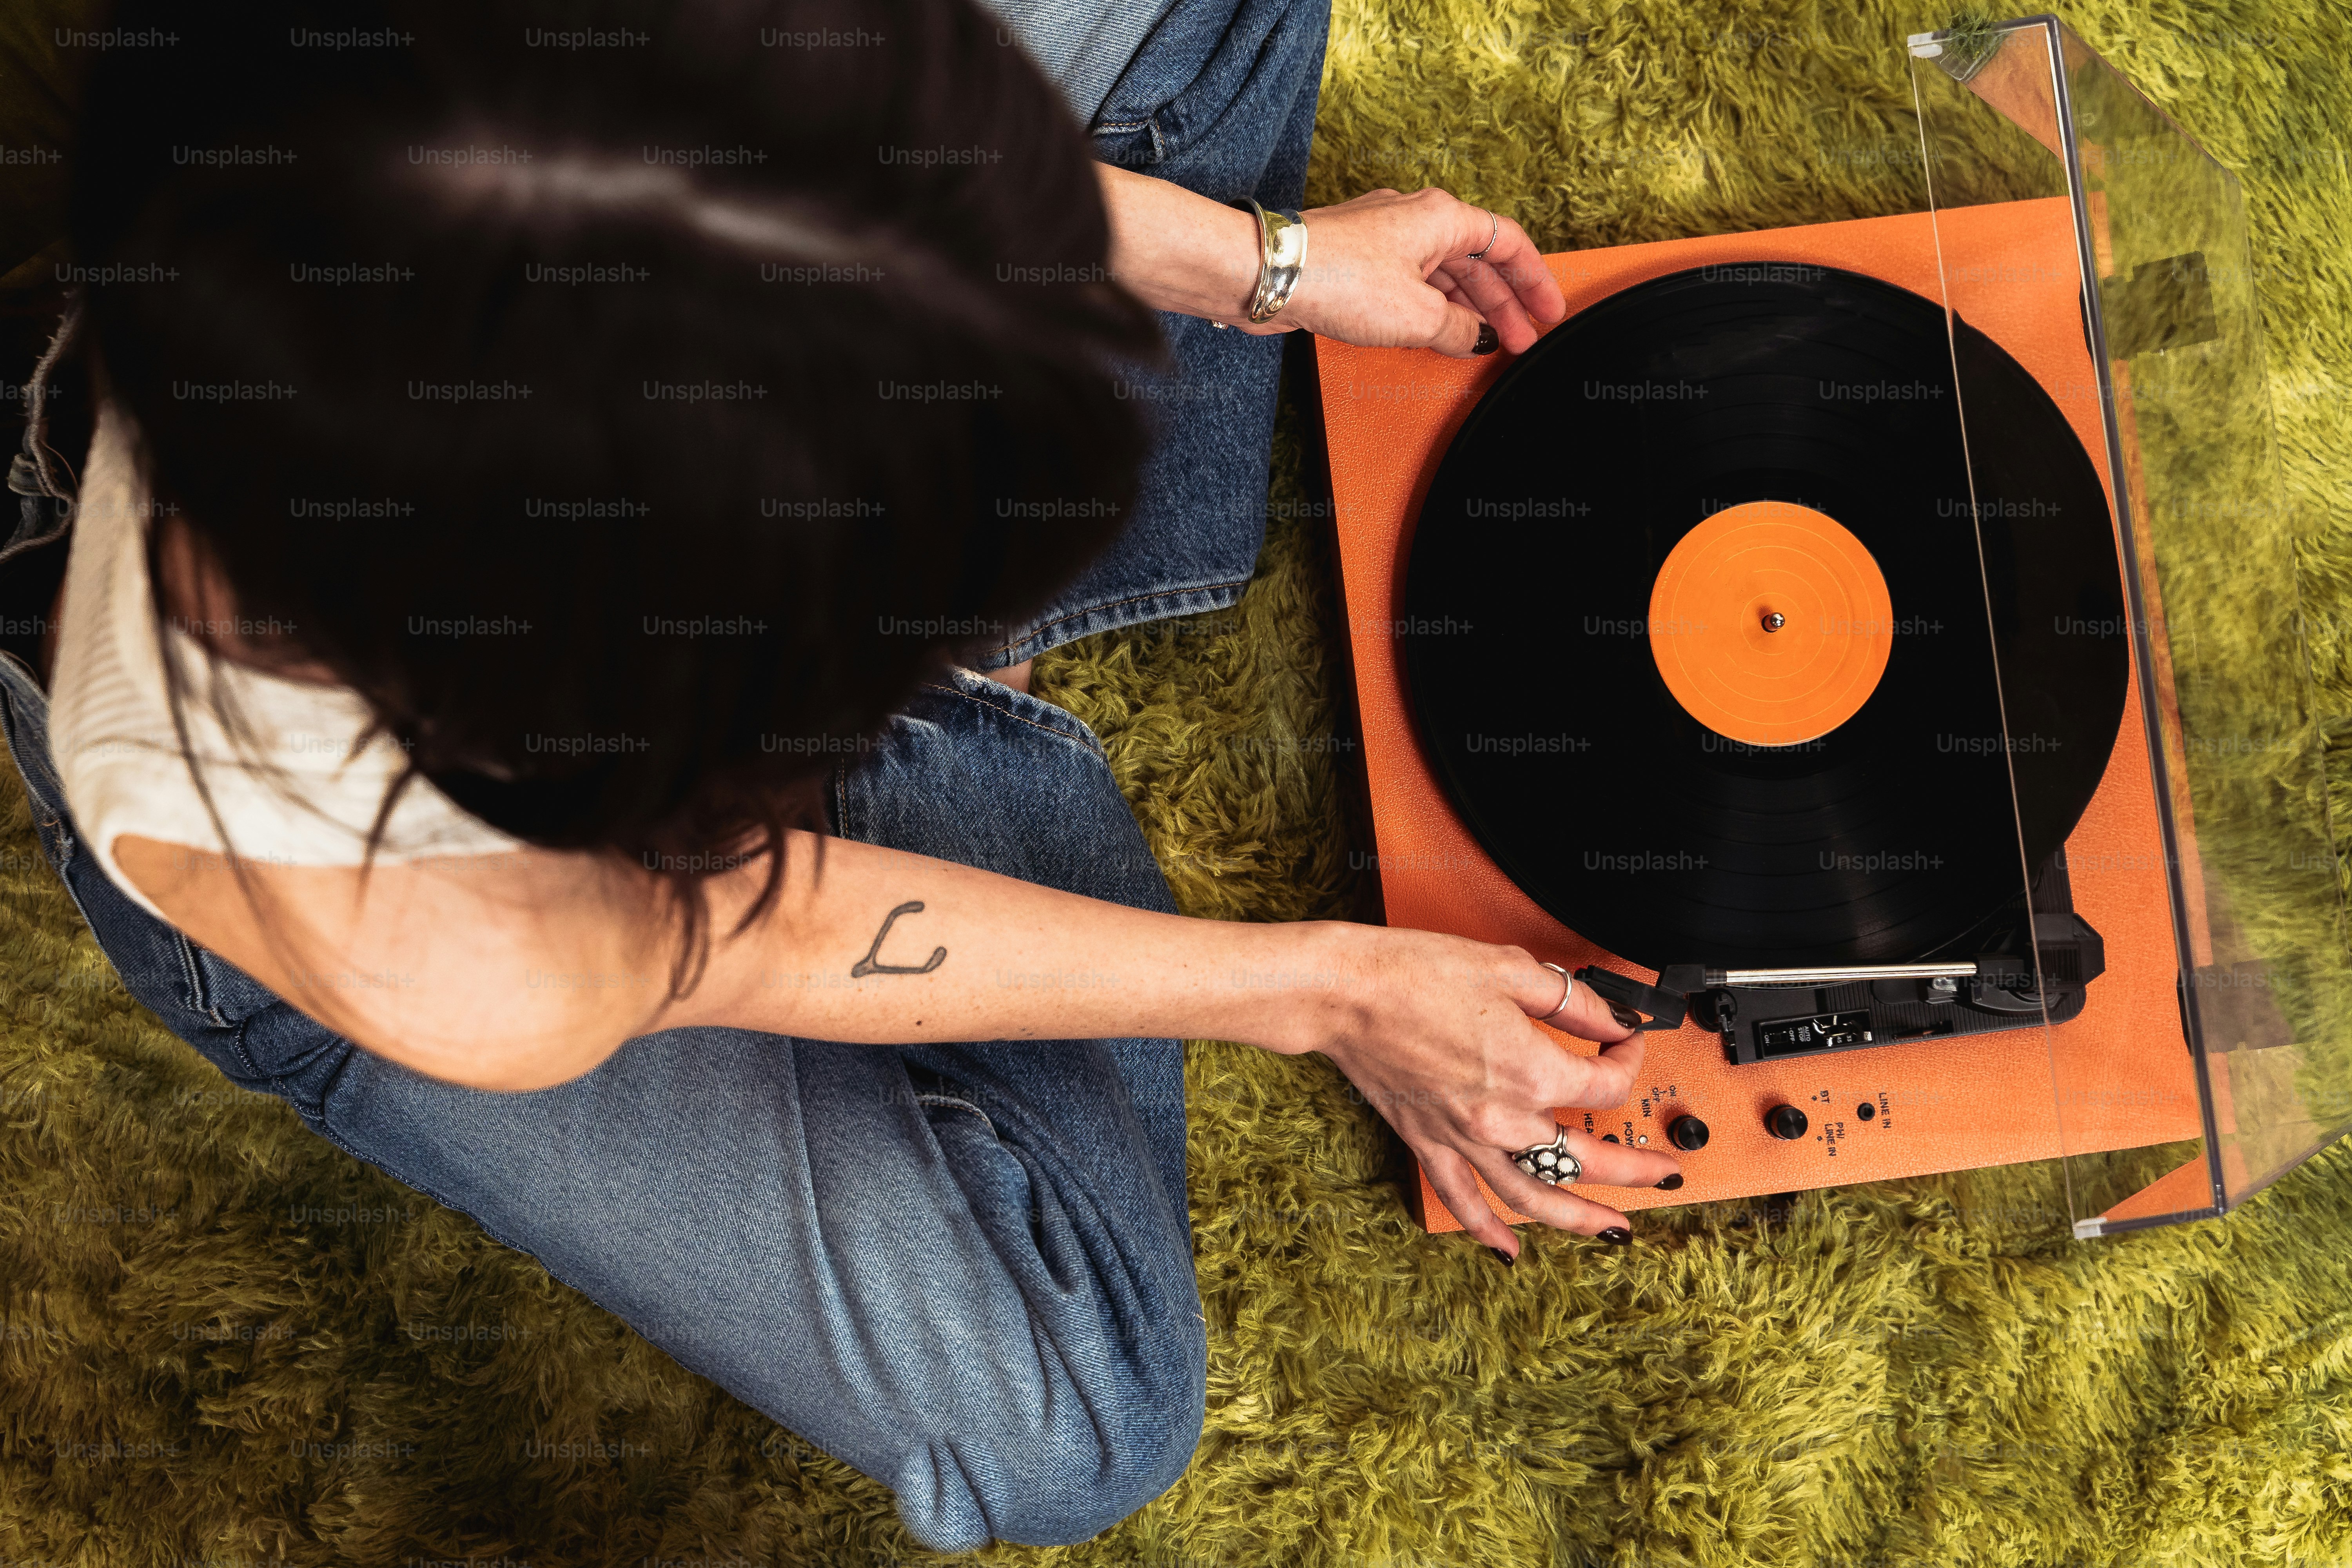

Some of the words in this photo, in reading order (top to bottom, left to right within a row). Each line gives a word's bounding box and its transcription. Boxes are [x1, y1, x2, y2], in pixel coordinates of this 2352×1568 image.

[1669, 1085, 1676, 1097] ON
[1820, 1090, 1830, 1103] BT
[1641, 1098, 1651, 1117] MIN
[1879, 1093, 1890, 1115] LINE
[1584, 1113, 1594, 1133] HEA
[1882, 1118, 1891, 1129] IN
[1623, 1122, 1635, 1149] POW
[1825, 1123, 1835, 1145] LINE
[1828, 1147, 1837, 1156] IN
